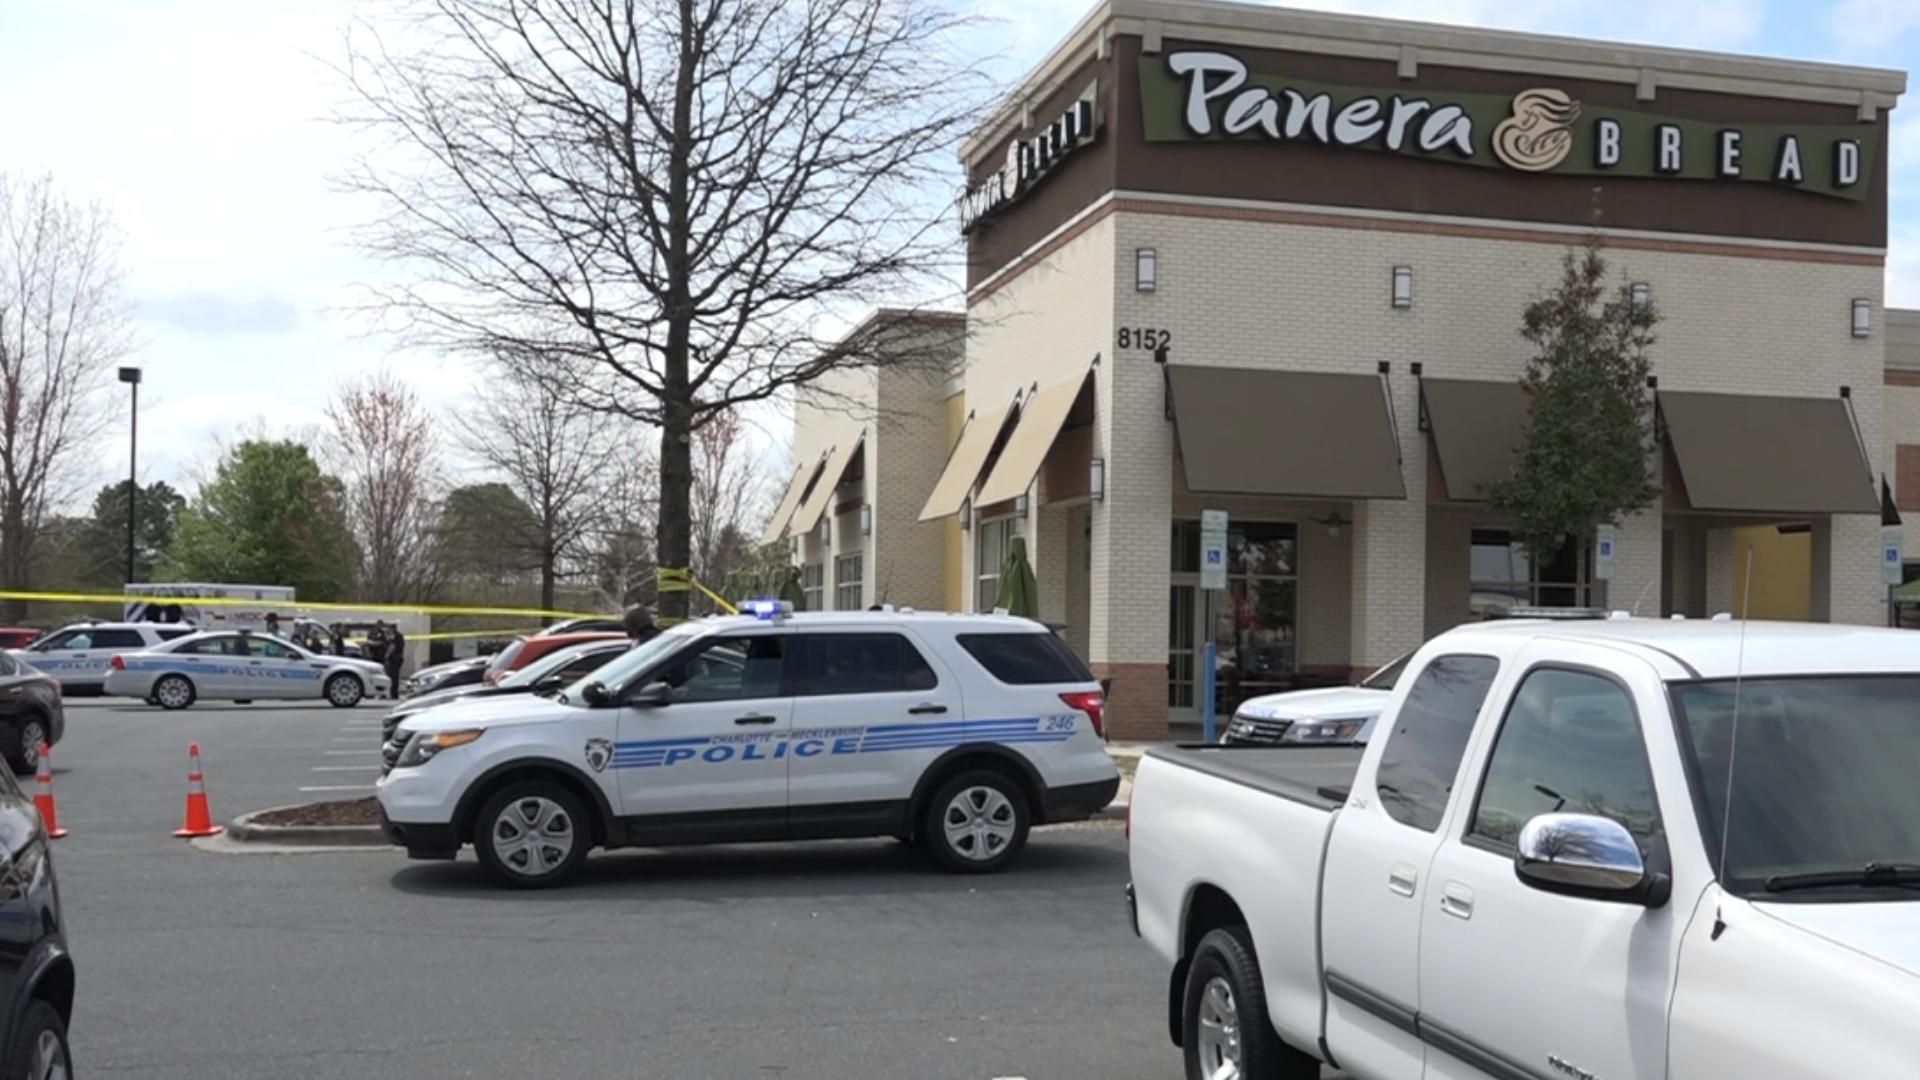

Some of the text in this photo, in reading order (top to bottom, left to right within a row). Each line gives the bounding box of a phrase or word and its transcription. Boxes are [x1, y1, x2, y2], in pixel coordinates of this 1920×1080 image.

[1168, 51, 1859, 185] Panera BREAD
[1117, 326, 1171, 351] 8152
[1045, 714, 1075, 731] 246
[711, 731, 772, 745] CHARLOTTE
[791, 726, 866, 740] MECKLENBURG
[664, 738, 861, 766] POLICE
